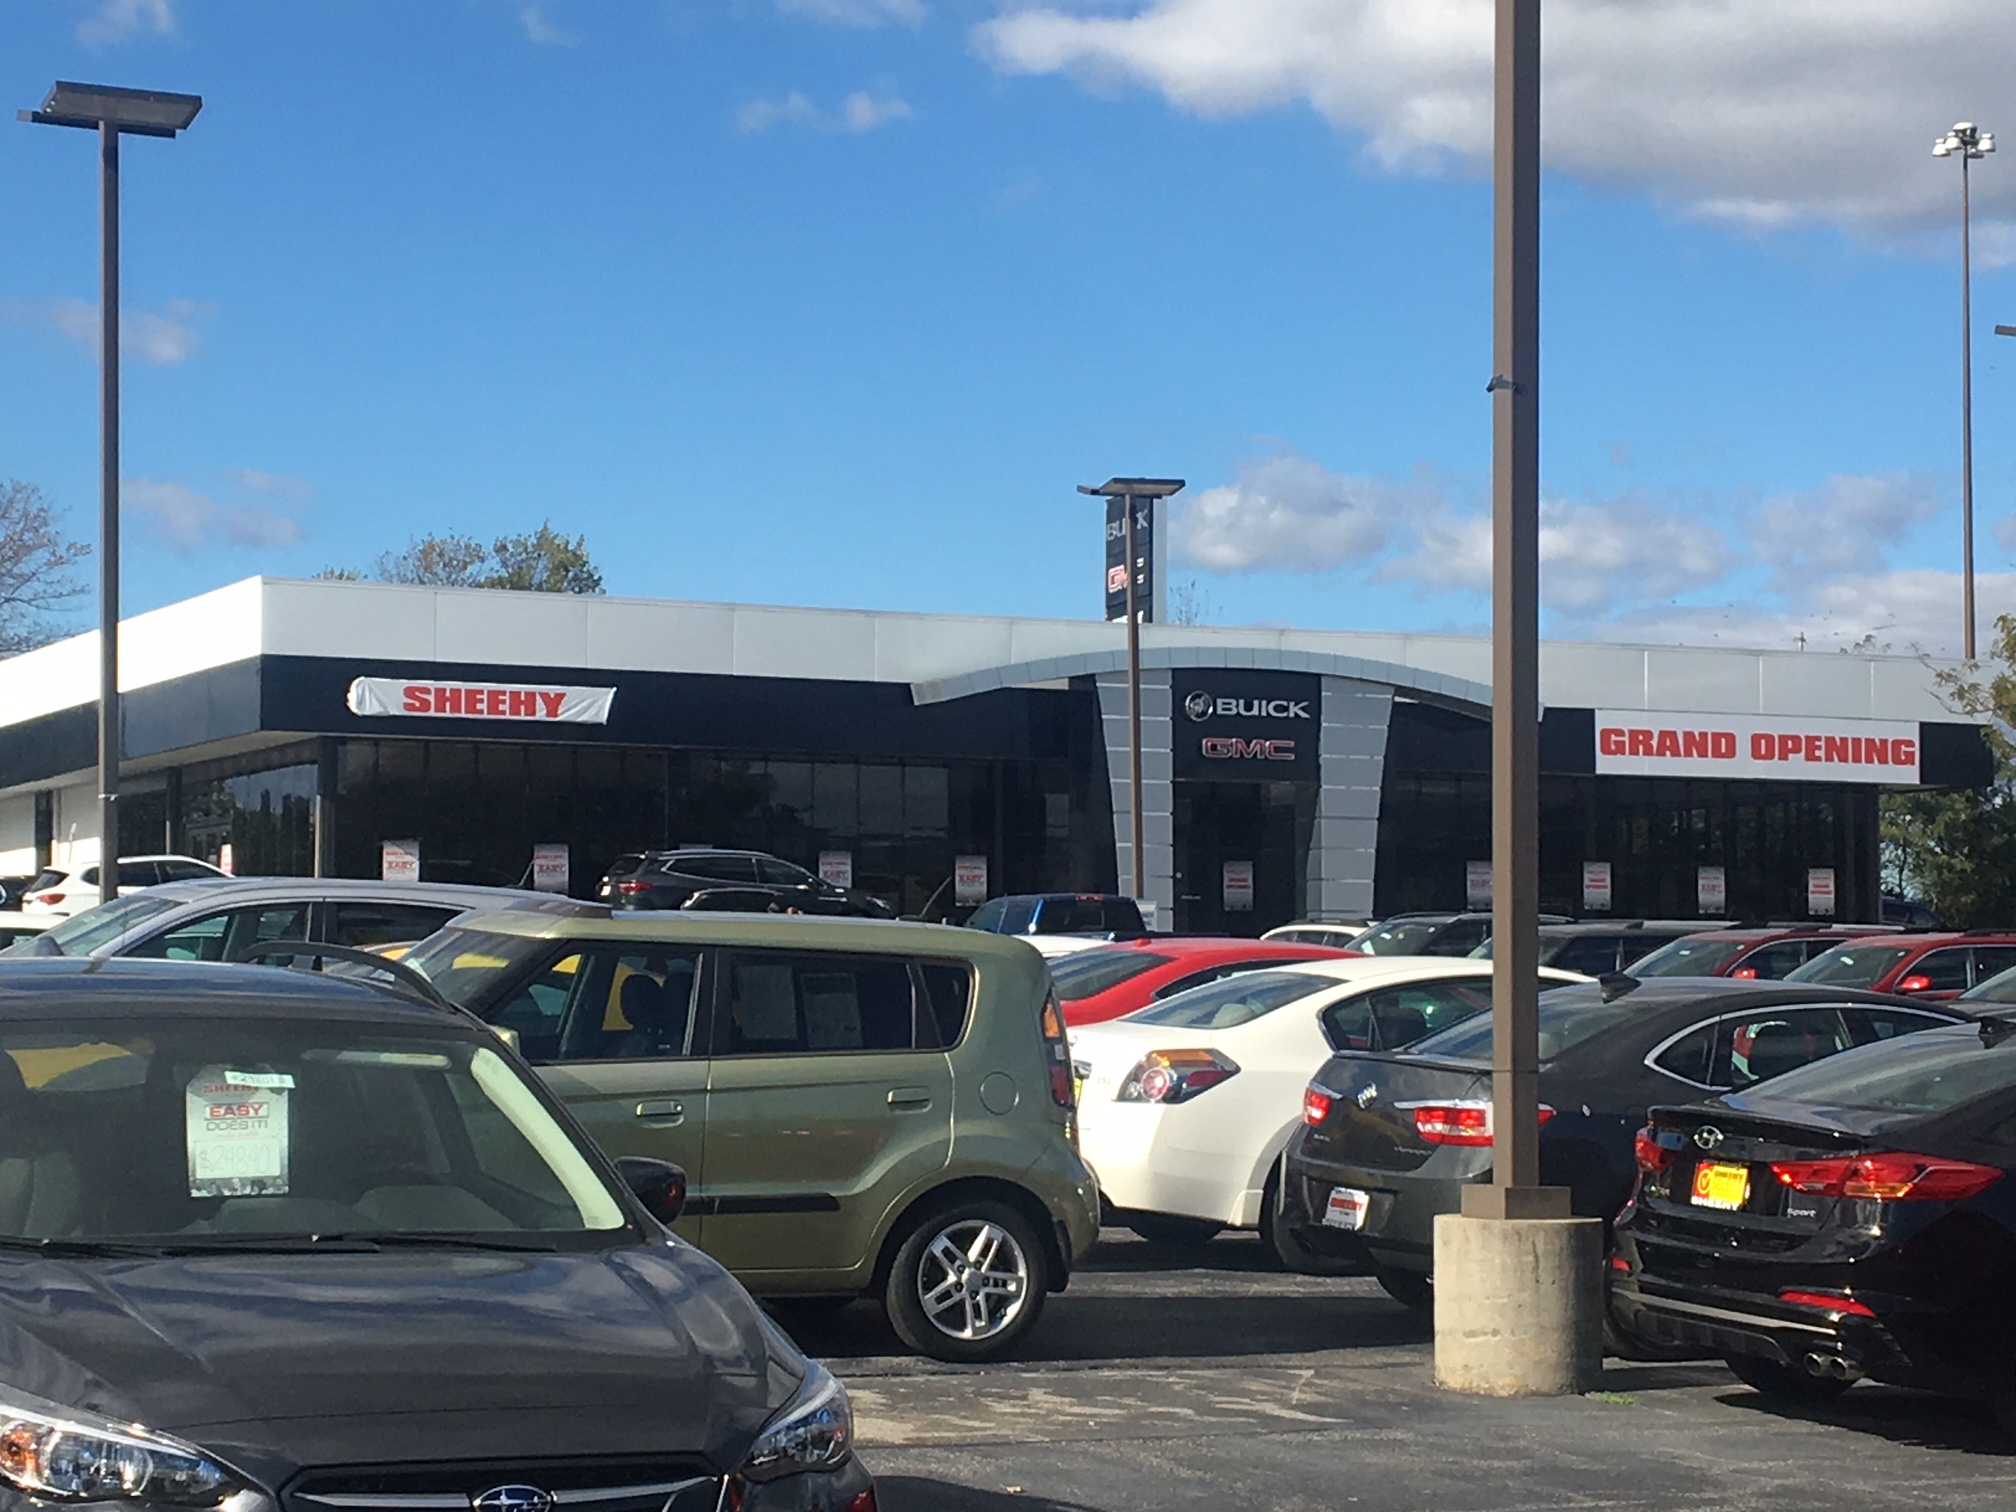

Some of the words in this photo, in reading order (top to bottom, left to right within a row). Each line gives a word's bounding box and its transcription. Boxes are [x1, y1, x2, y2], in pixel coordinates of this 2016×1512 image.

[1107, 509, 1148, 540] BUK
[402, 686, 566, 718] SHEEHY
[1216, 698, 1310, 718] BUICK
[1202, 737, 1295, 760] GMC
[1599, 727, 1737, 759] GRAND
[1750, 732, 1916, 766] OPENING
[209, 1102, 264, 1119] EASY
[206, 1119, 250, 1131] DOES
